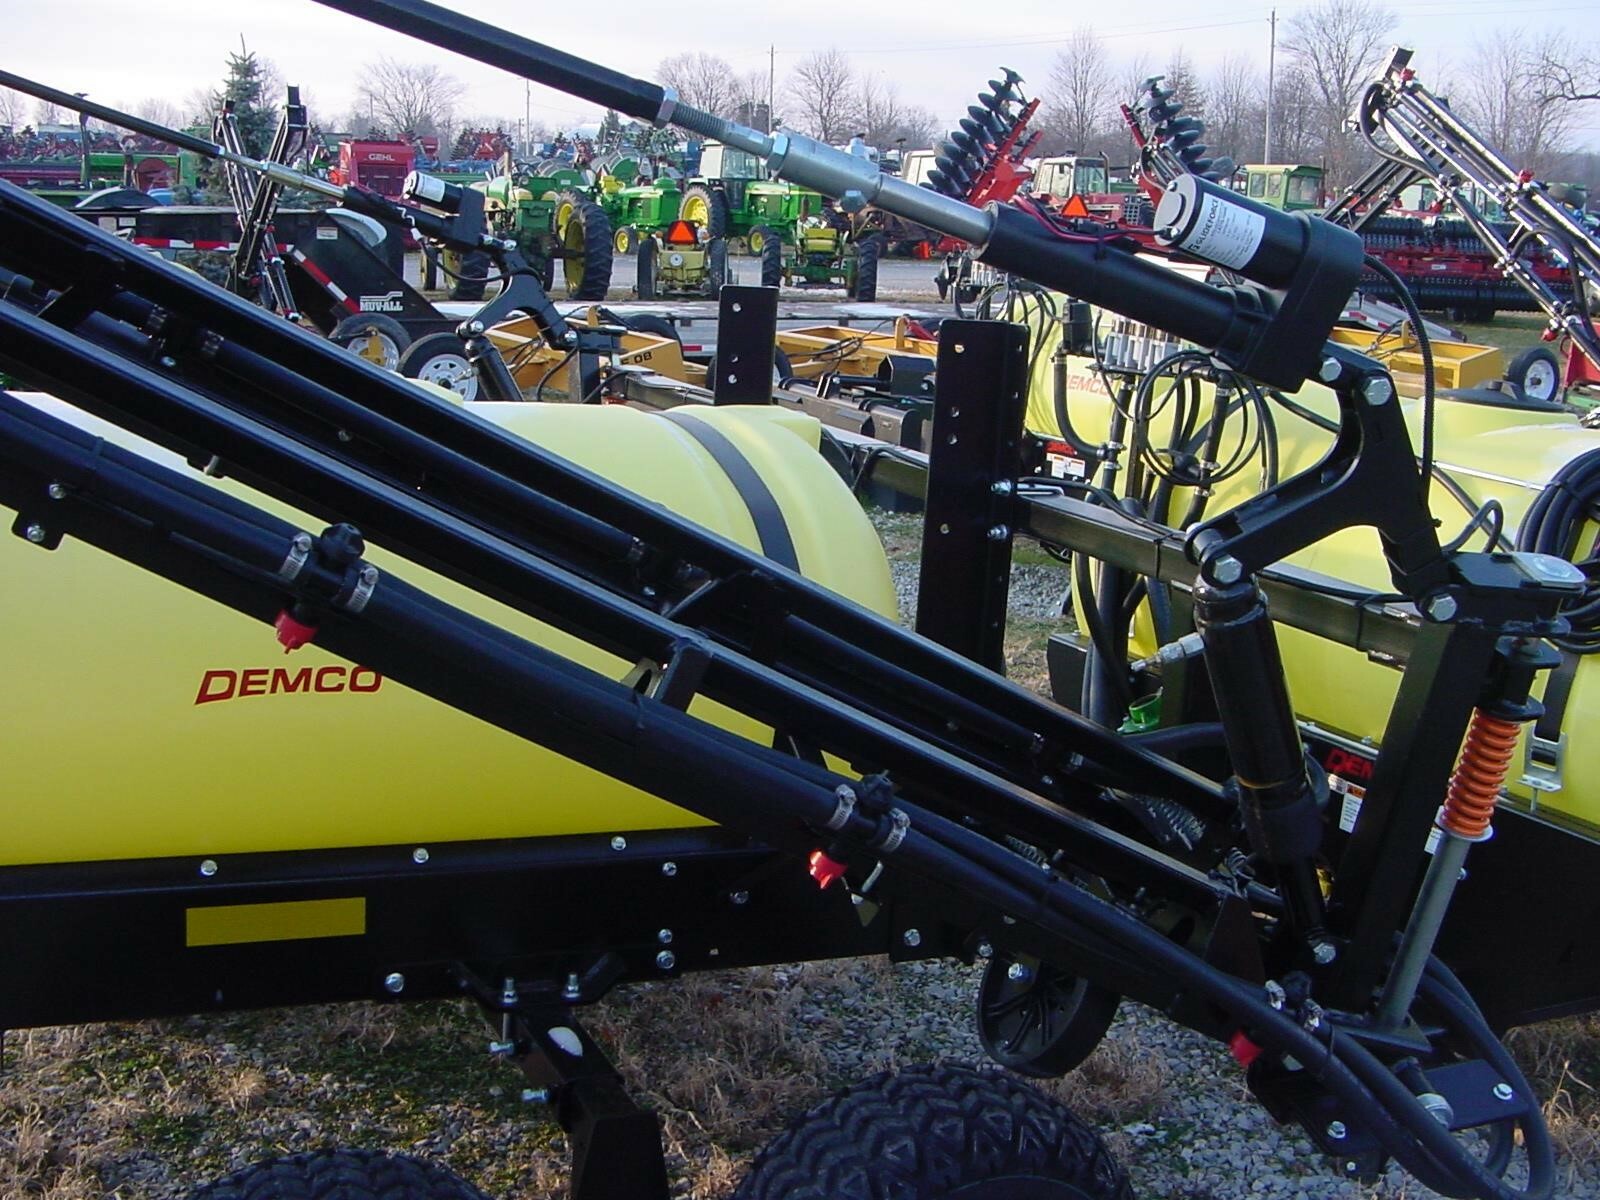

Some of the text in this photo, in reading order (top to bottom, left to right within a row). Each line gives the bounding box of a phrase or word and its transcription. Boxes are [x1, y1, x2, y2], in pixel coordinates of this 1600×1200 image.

[368, 153, 396, 161] GEHL
[360, 300, 403, 312] MUV-ALL
[194, 665, 383, 706] DEMCO
